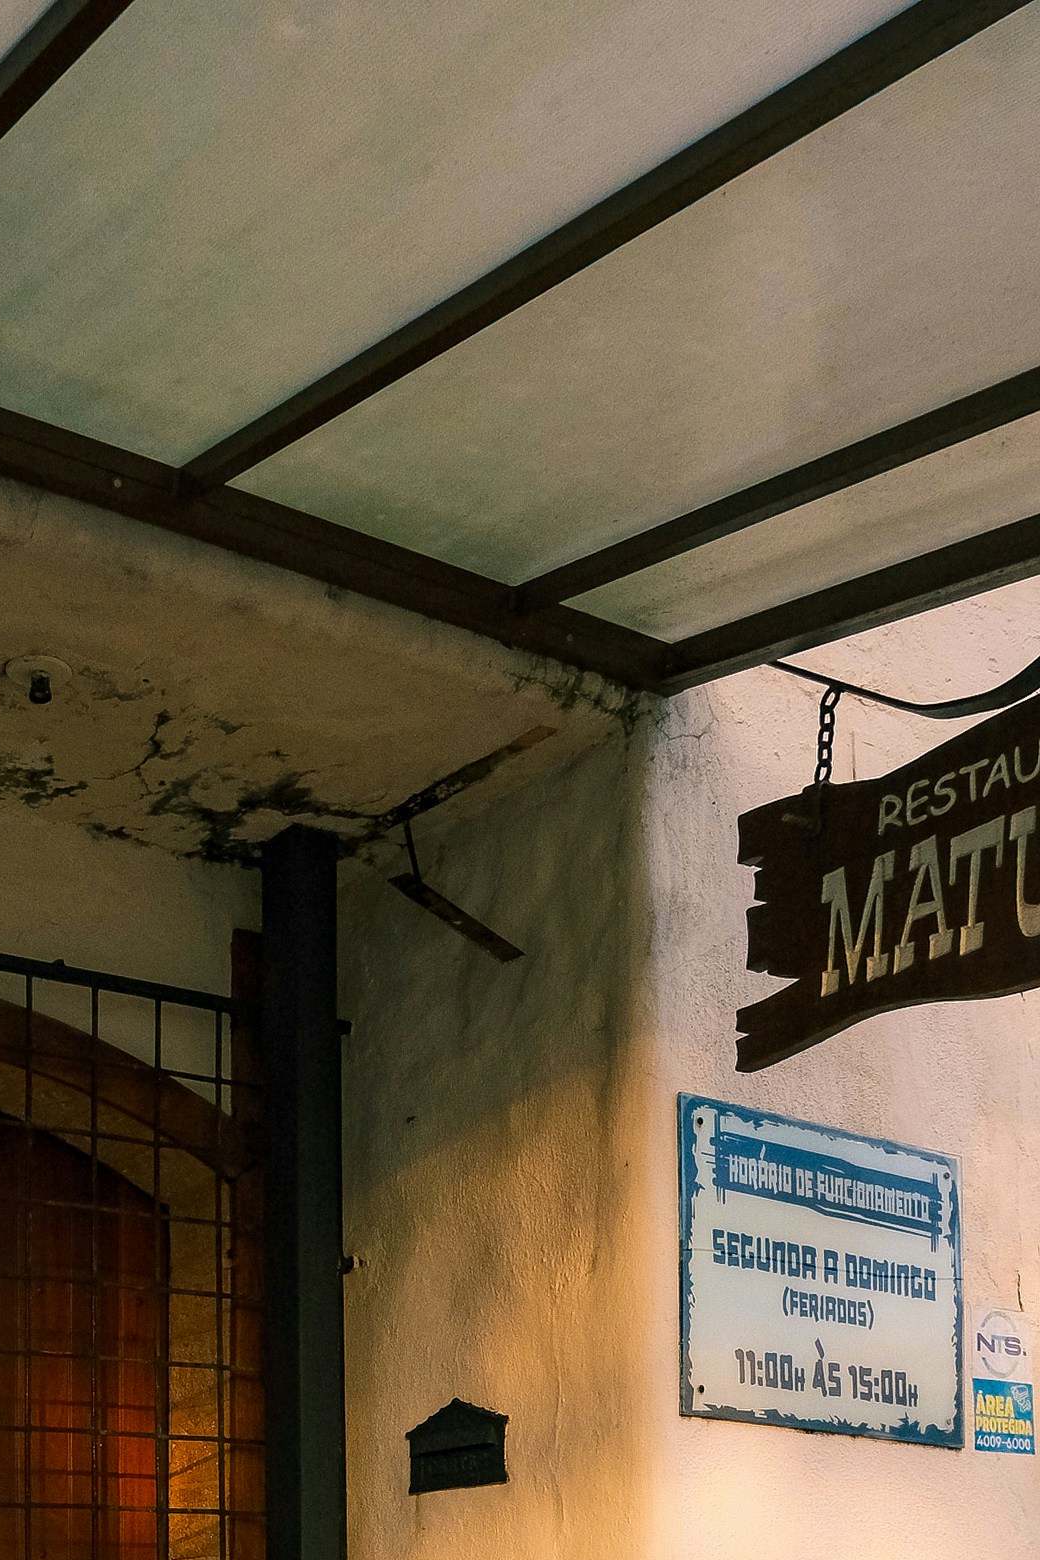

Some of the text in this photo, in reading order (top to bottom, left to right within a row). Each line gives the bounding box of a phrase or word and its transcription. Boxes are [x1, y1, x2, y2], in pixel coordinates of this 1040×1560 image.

[729, 1146, 930, 1220] HORÁRIO DE FUNCIONAMENTO
[712, 1229, 937, 1301] SEGUNDA A DOMINGO
[782, 1286, 874, 1329] (FERIADOS)
[812, 1338, 841, 1399] ÀS
[976, 1389, 1014, 1417] ÁREA
[975, 1416, 1033, 1436] PROTEGIDA
[976, 1435, 1031, 1451] 4009-6000
